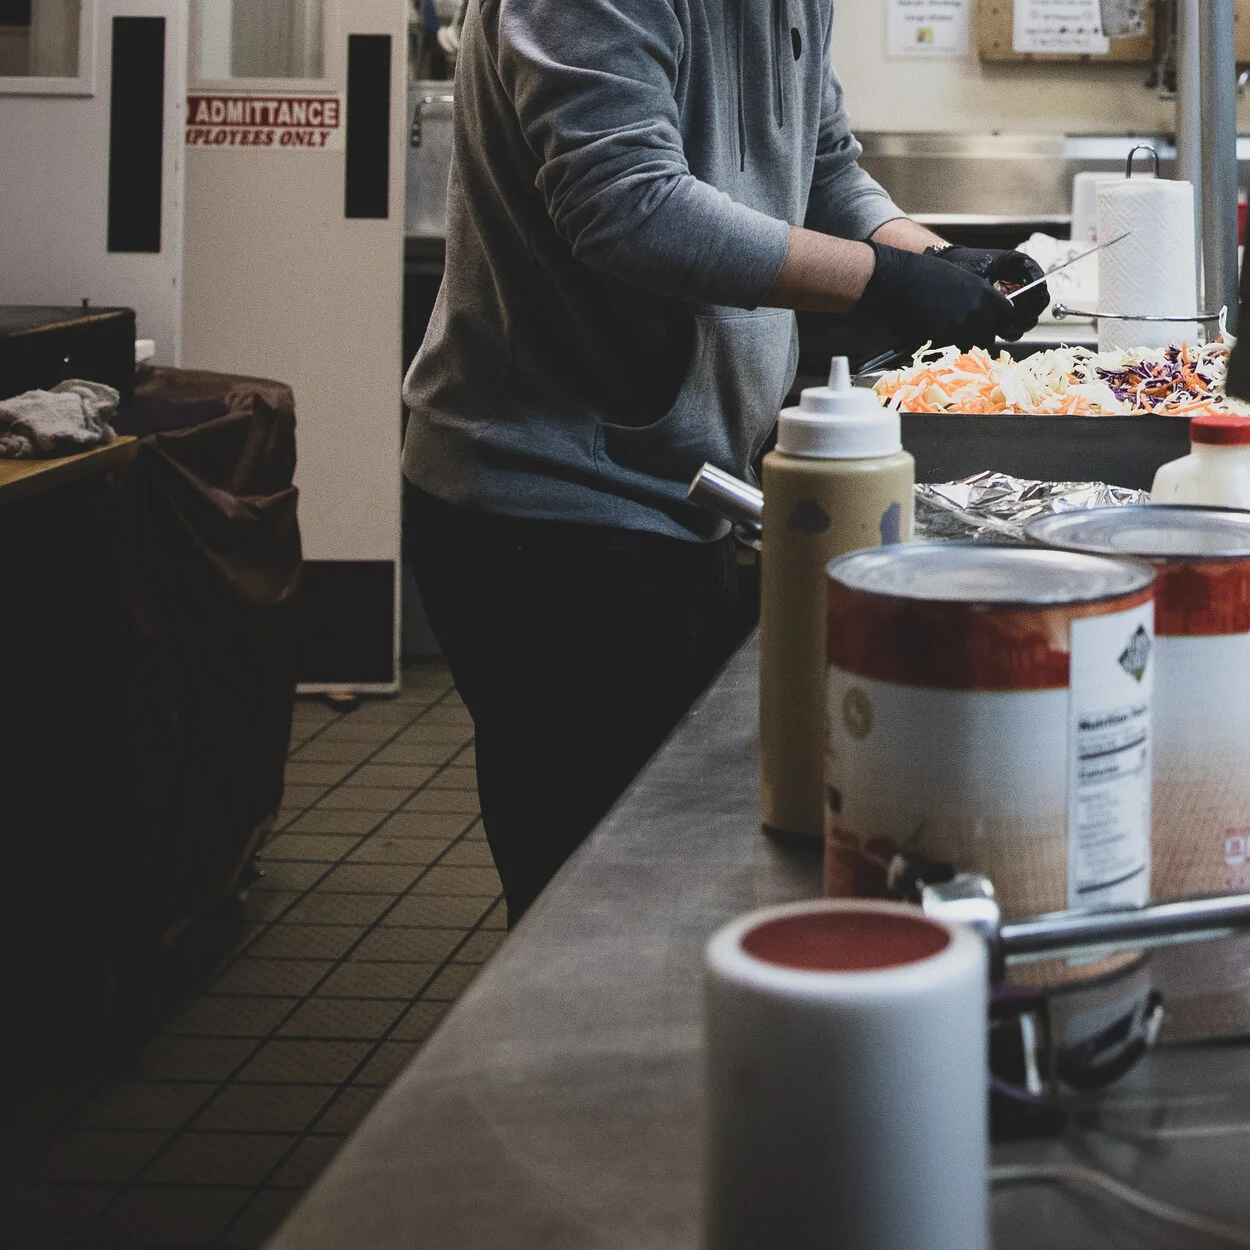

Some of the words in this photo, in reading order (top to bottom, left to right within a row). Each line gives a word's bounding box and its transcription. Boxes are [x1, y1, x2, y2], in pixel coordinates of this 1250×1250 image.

[195, 100, 337, 126] ADMITTANCE
[186, 129, 274, 147] PLOYEES
[278, 130, 330, 147] ONLY
